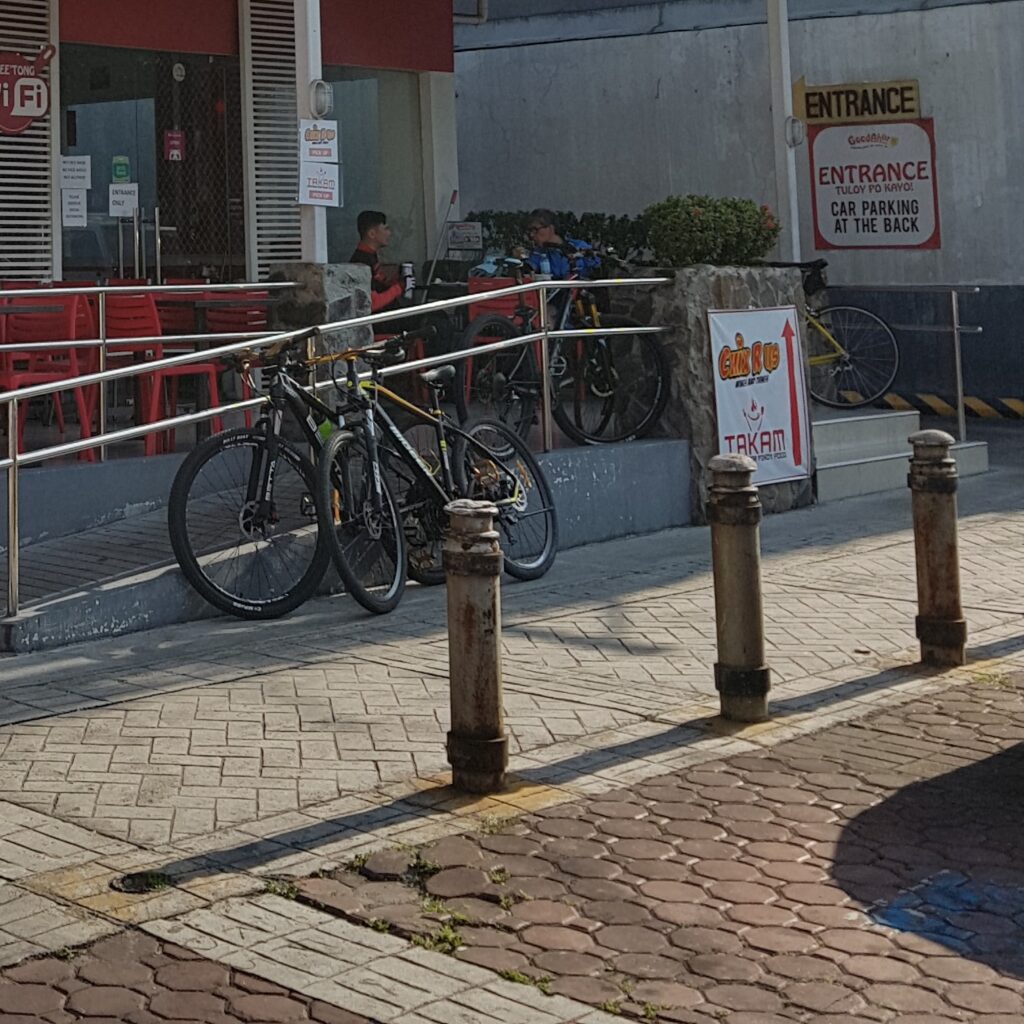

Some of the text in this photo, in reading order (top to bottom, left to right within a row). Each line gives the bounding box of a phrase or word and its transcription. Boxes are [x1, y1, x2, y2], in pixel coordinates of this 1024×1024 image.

[805, 86, 915, 119] ENTRANCE
[818, 161, 930, 186] ENTRANCE
[835, 182, 915, 196] TULOY PO KAYO!
[831, 199, 920, 217] CAR PARKING
[834, 216, 920, 234] AT THE BACK
[724, 429, 786, 456] TAKAM
